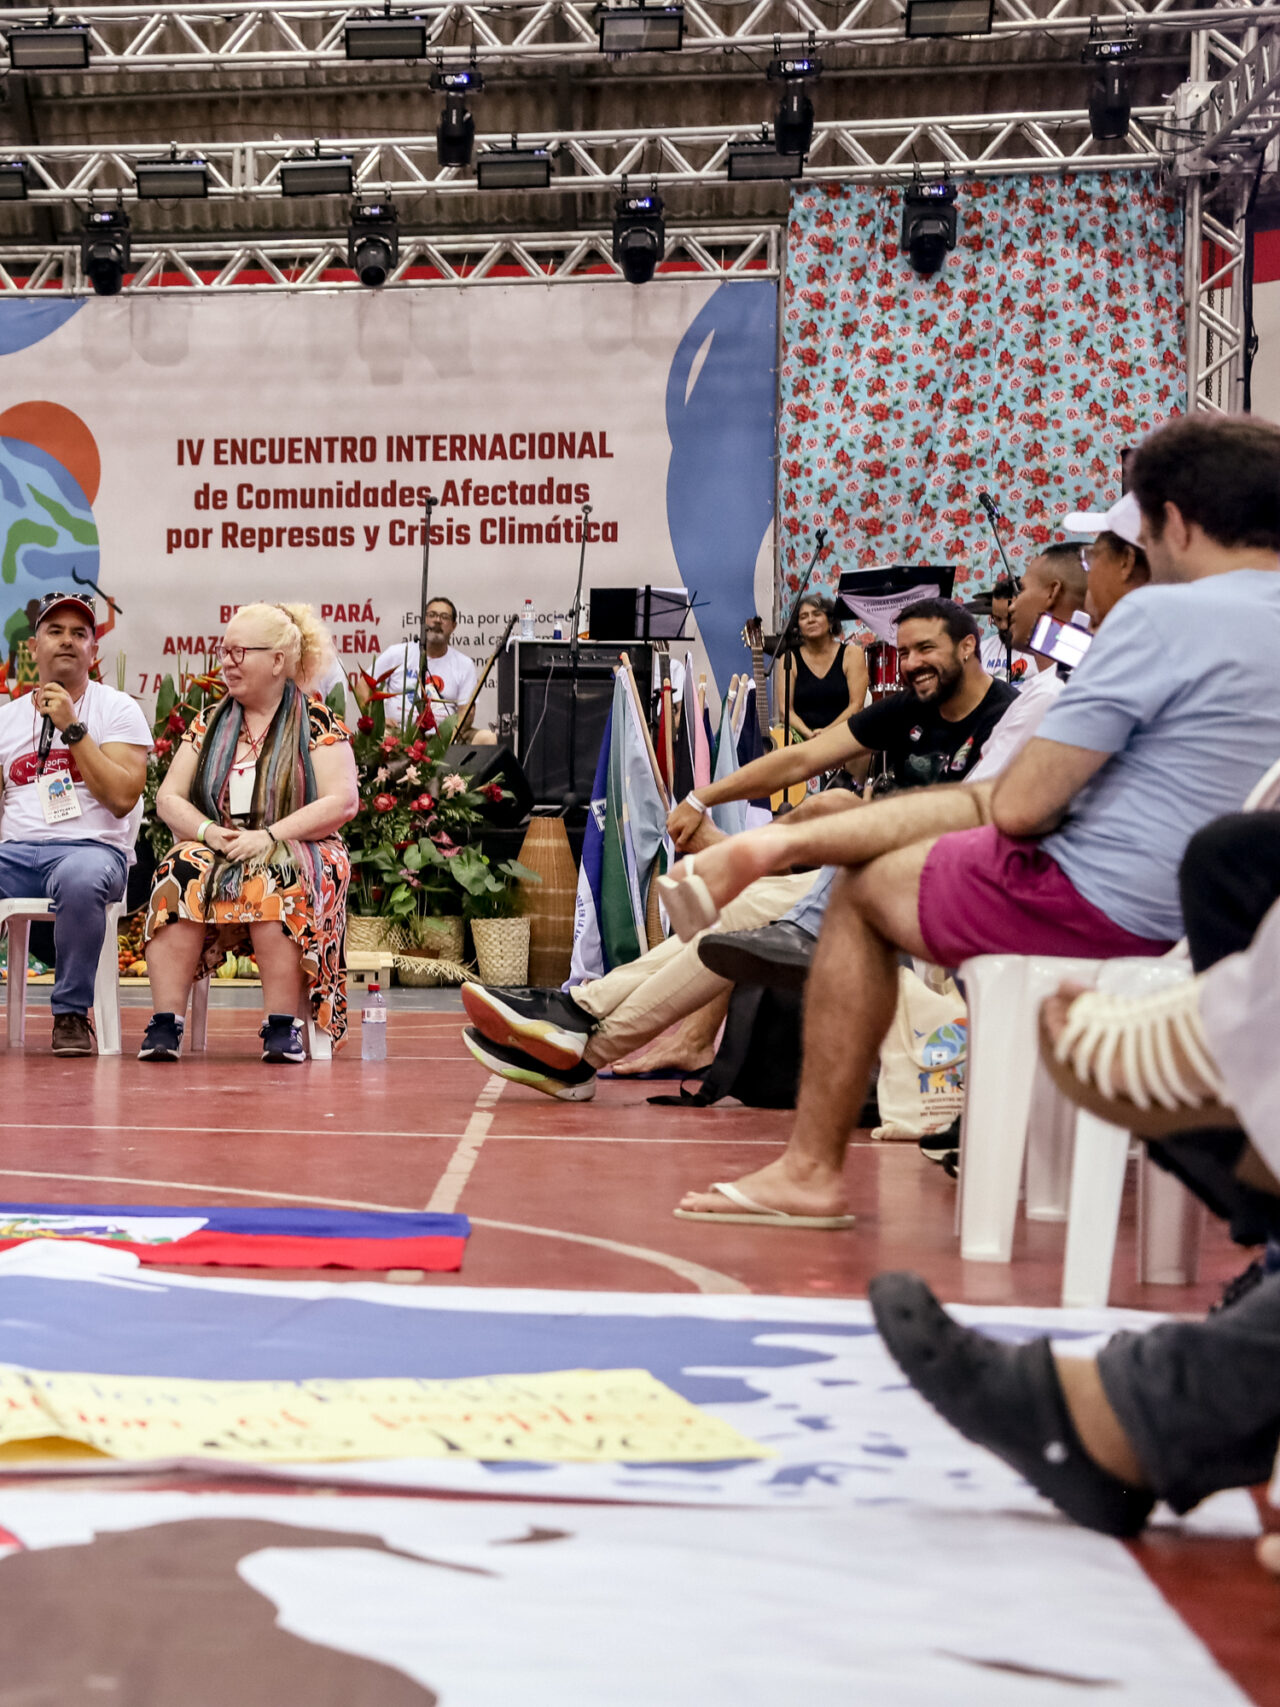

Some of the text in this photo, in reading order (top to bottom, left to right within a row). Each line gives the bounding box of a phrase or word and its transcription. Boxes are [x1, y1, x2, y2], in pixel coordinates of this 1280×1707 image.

[177, 431, 615, 466] IV ENCUENTRO INTERNACIONAL
[194, 476, 591, 510] de Comunidades Afectadas
[166, 514, 619, 554] por Represas y Crisis Climática
[320, 597, 381, 627] PARÁ,
[478, 614, 500, 629] por
[473, 632, 485, 646] al
